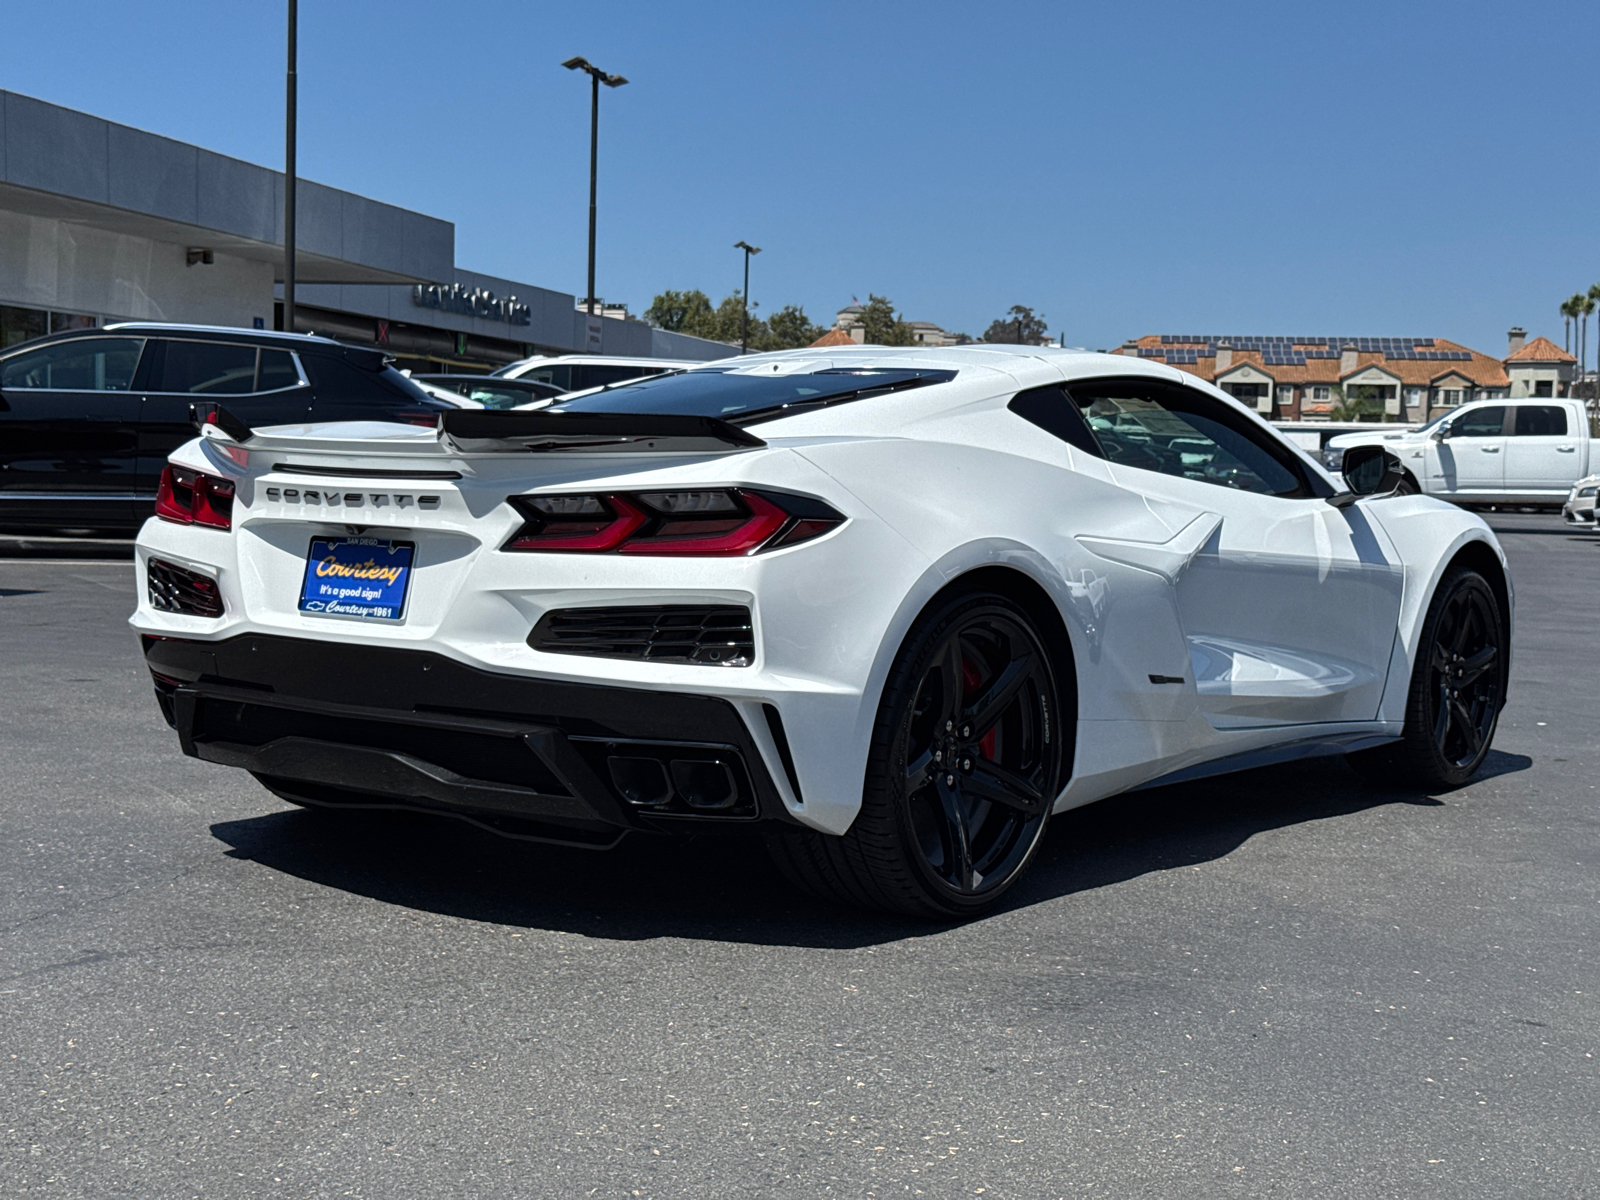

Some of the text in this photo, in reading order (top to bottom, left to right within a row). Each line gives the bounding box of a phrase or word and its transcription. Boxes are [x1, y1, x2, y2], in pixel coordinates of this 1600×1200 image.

[266, 487, 441, 504] CORVETTE
[346, 537, 379, 546] SAN DIEGO
[316, 555, 403, 587] Courtesy
[320, 584, 382, 601] It's a good sign!
[326, 599, 368, 619] Courtesy
[373, 606, 392, 618] 1961
